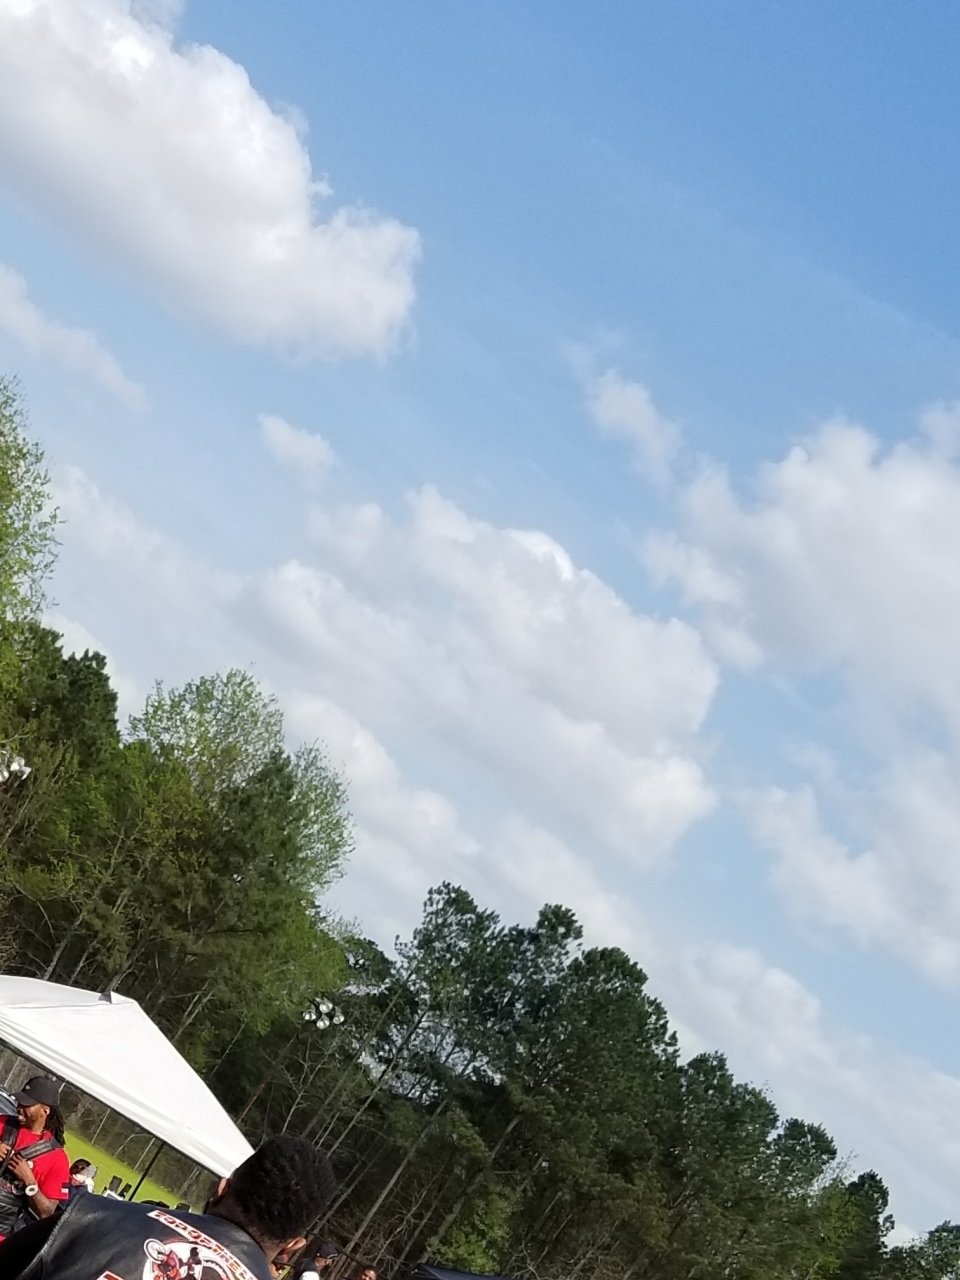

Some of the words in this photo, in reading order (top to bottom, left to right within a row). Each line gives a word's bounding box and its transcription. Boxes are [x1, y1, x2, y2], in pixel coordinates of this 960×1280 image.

[154, 1211, 189, 1231] TOP
[188, 1230, 213, 1247] OF
[212, 1242, 242, 1272] THE
